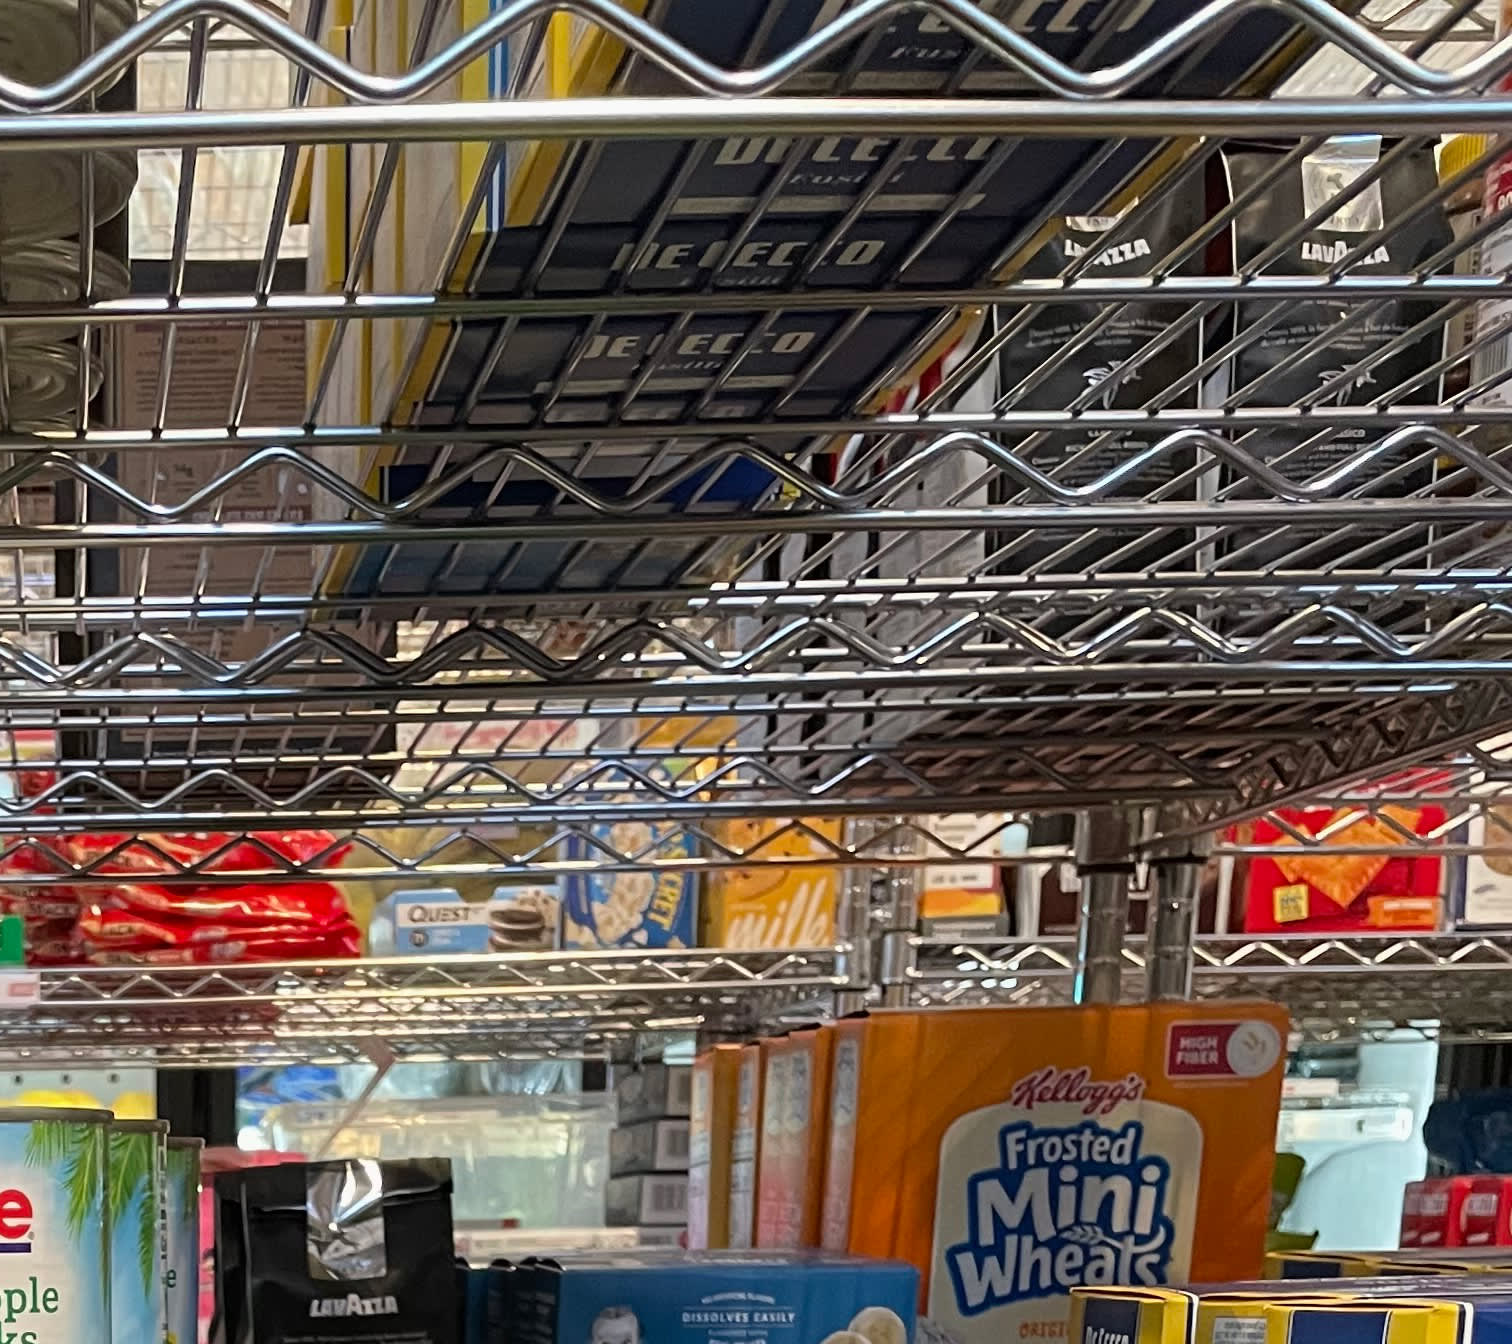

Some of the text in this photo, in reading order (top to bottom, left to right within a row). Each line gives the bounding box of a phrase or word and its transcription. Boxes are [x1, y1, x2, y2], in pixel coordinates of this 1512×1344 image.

[408, 905, 472, 923] QUEST
[1179, 1035, 1219, 1051] HIGH
[1176, 1050, 1219, 1065] FIBER
[1011, 1064, 1146, 1114] Kellogg's
[1005, 1126, 1136, 1169] Frosted
[976, 1165, 1162, 1248] Mini
[953, 1233, 1161, 1308] Wheats
[309, 1293, 399, 1318] LAVAZZA
[681, 1312, 796, 1323] DISSOLVES EASILY
